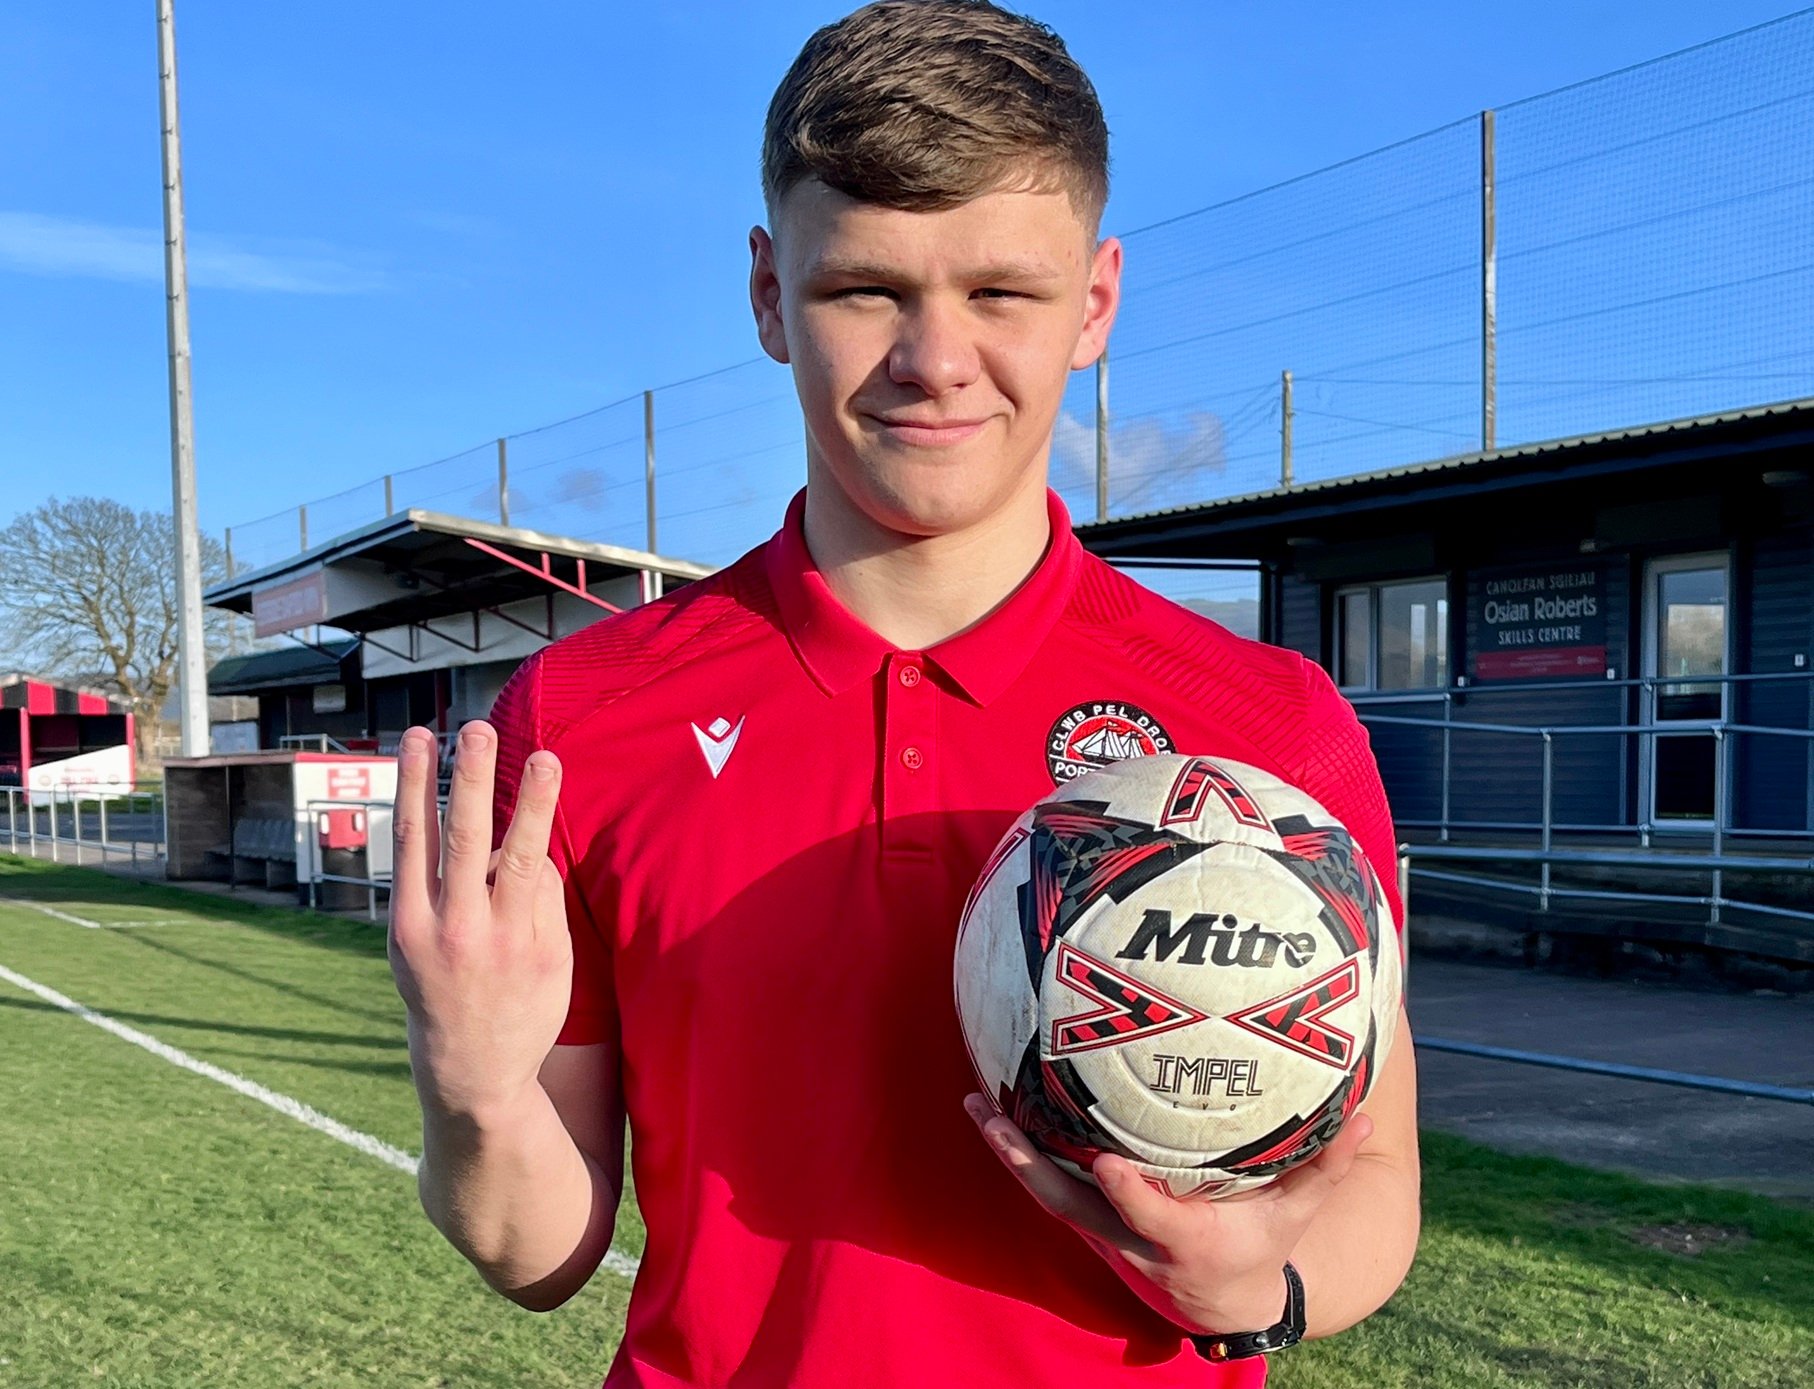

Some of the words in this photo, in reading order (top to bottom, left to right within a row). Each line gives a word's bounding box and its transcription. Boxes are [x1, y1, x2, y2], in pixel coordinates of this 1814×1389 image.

[1484, 600, 1530, 624] Osian
[1534, 594, 1597, 621] Roberts
[1498, 628, 1534, 645] SKILLS
[1538, 625, 1581, 642] CENTRE
[1052, 710, 1086, 751] CLWB
[1092, 704, 1129, 718] PEL
[1115, 909, 1317, 968] Mitre
[1150, 1054, 1263, 1096] IMPEL
